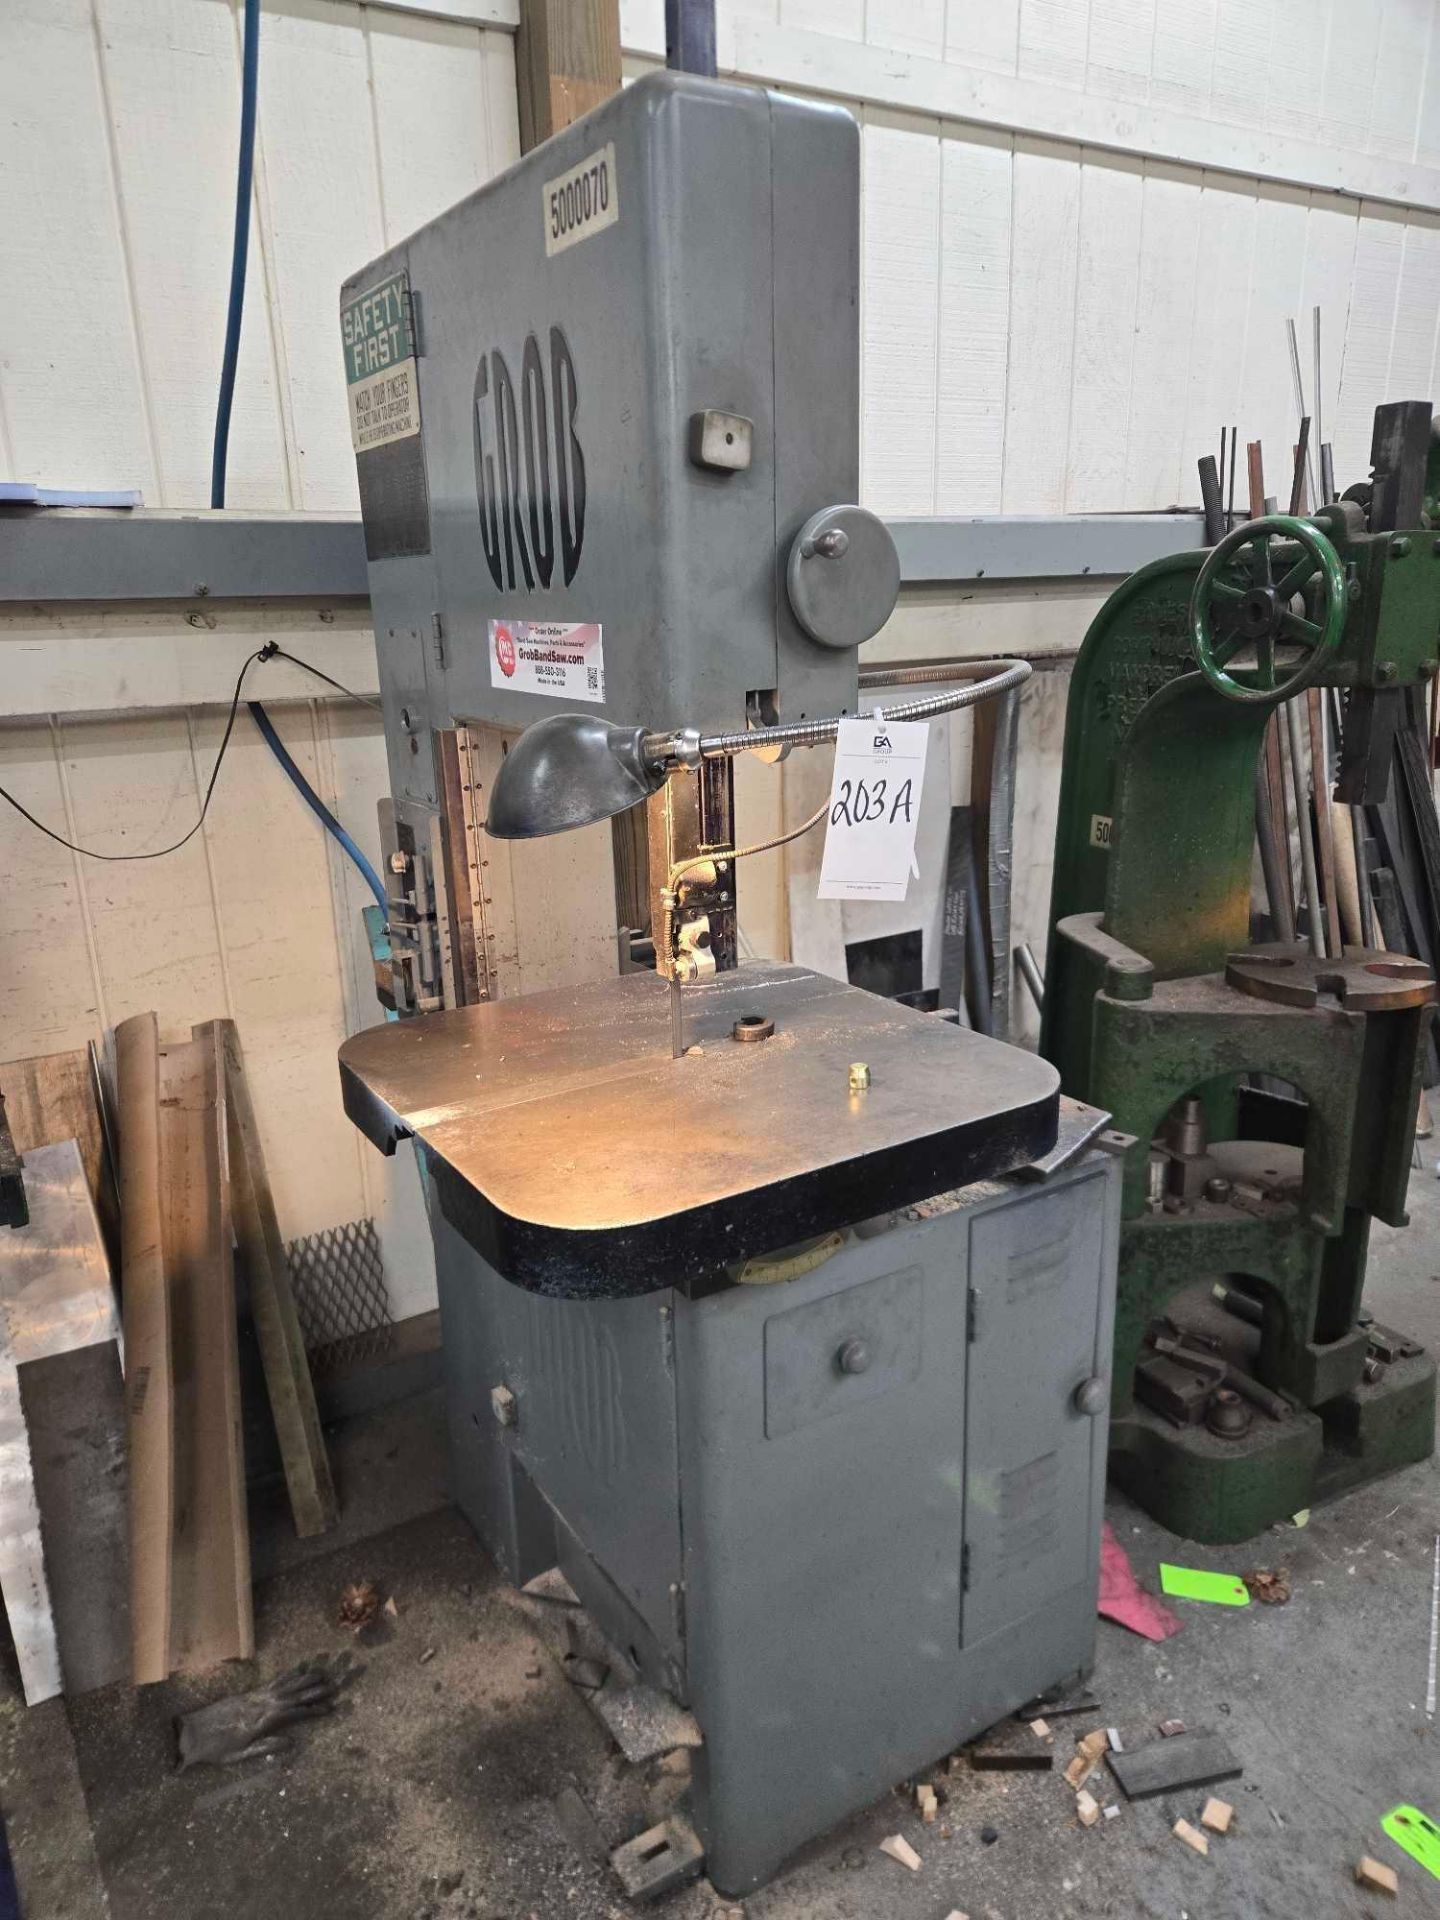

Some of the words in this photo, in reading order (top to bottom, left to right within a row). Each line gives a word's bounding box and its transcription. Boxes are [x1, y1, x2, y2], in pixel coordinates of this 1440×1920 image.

[551, 161, 608, 239] 5000070
[342, 280, 404, 346] SAFETY
[353, 325, 400, 377] FIRST
[355, 389, 371, 413] WATCH
[373, 382, 386, 406] YOUR
[387, 372, 409, 401] FINGERS
[473, 325, 586, 593] GROB
[518, 647, 585, 665] GrobBandSaw.com
[548, 627, 562, 636] Online
